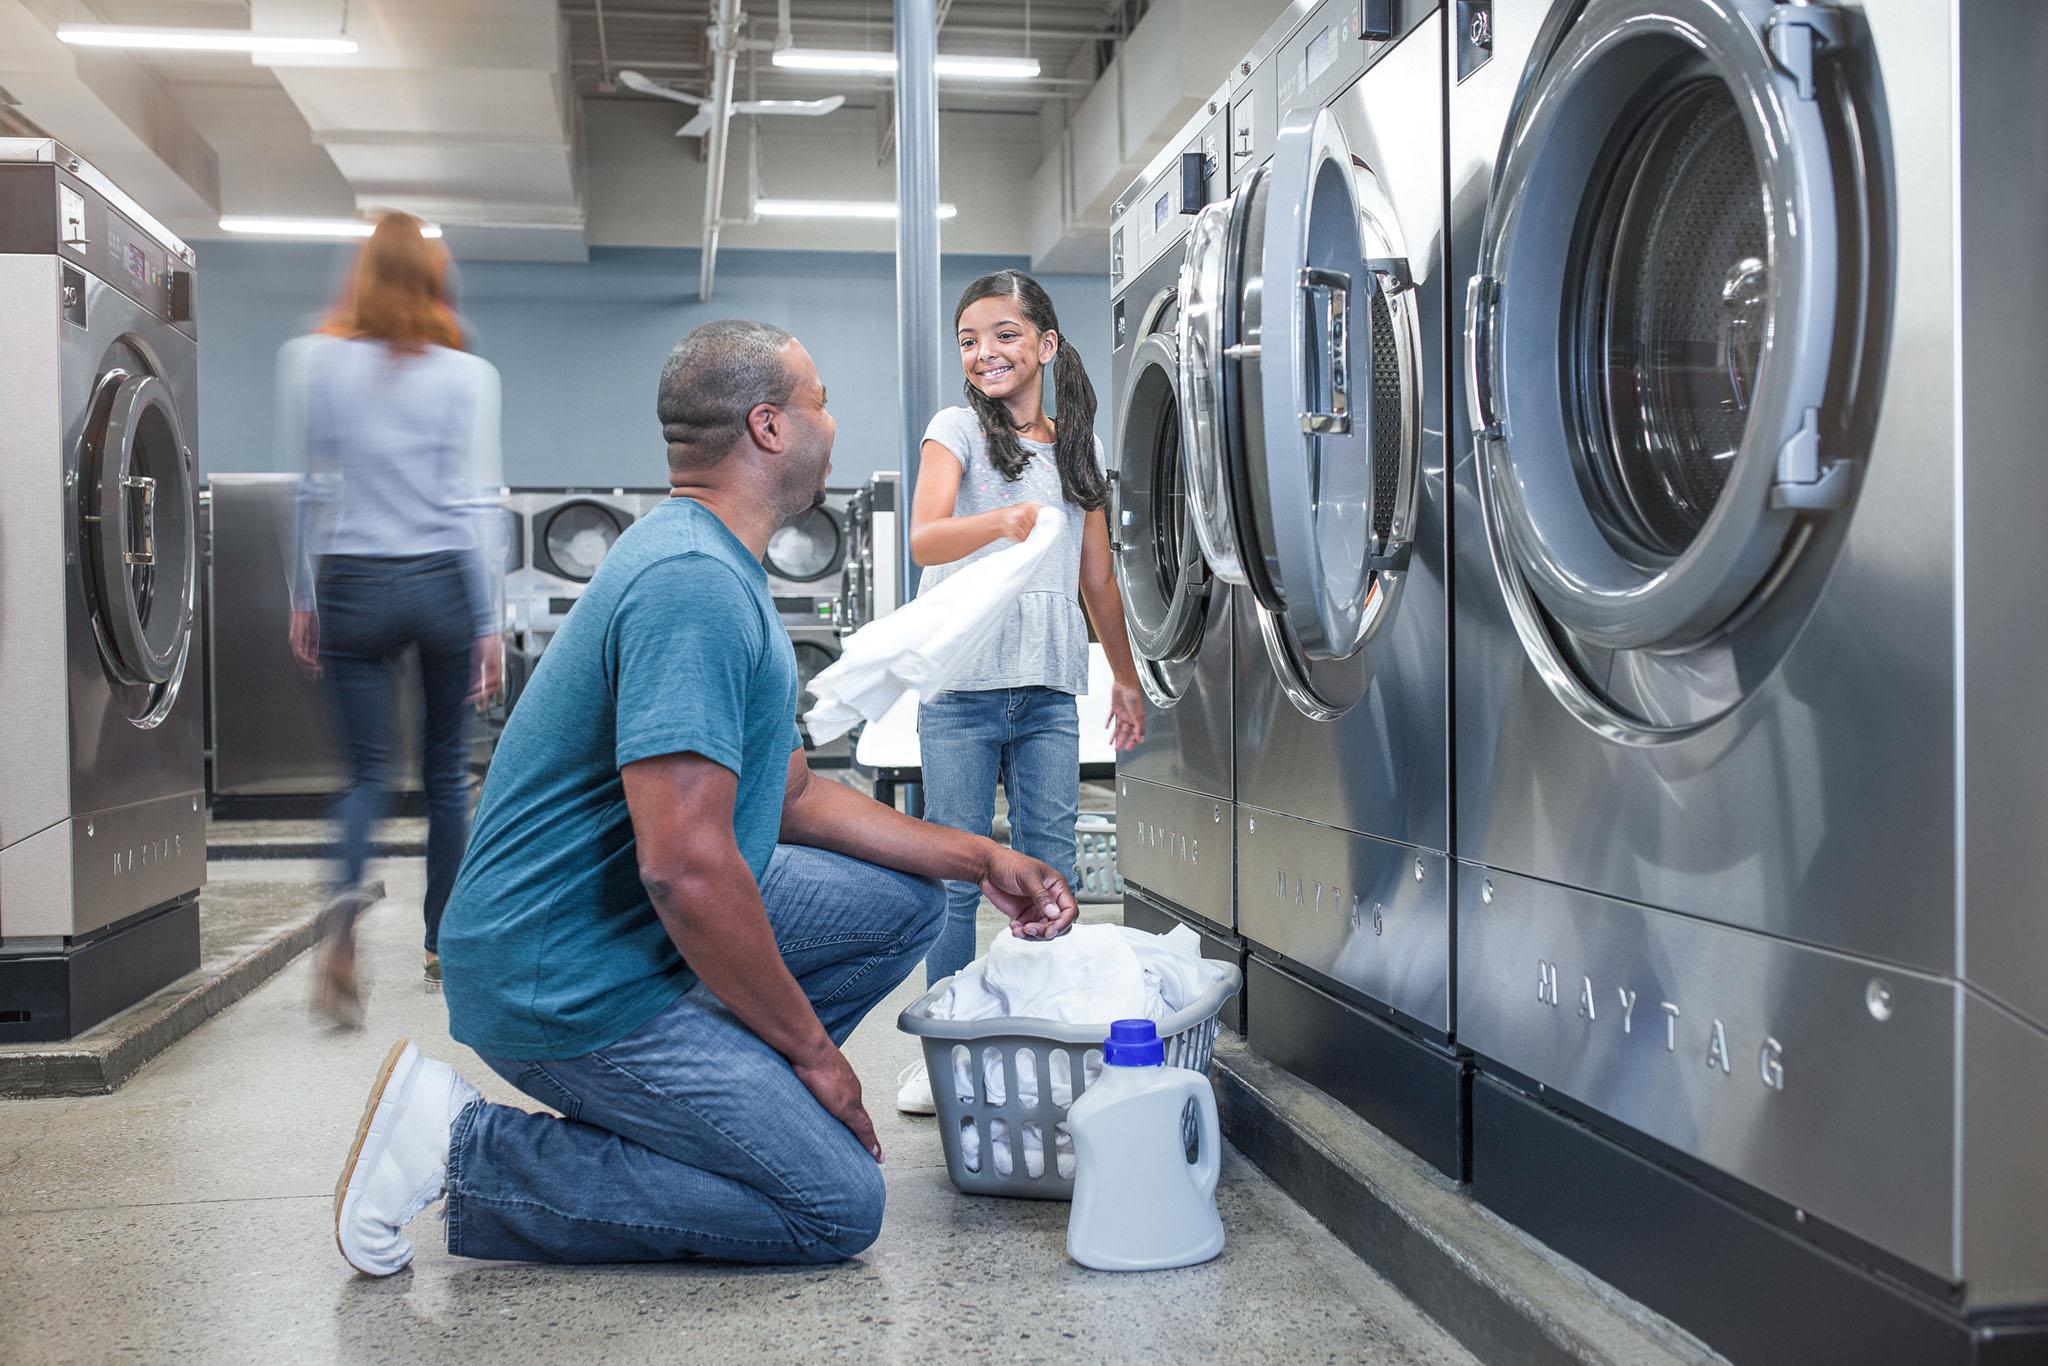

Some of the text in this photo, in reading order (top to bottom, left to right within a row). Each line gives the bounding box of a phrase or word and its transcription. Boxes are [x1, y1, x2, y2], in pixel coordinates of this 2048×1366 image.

[1136, 820, 1199, 865] MAYTAG
[1275, 867, 1383, 936] MAYTAG
[1537, 959, 1784, 1090] MAYTAG
